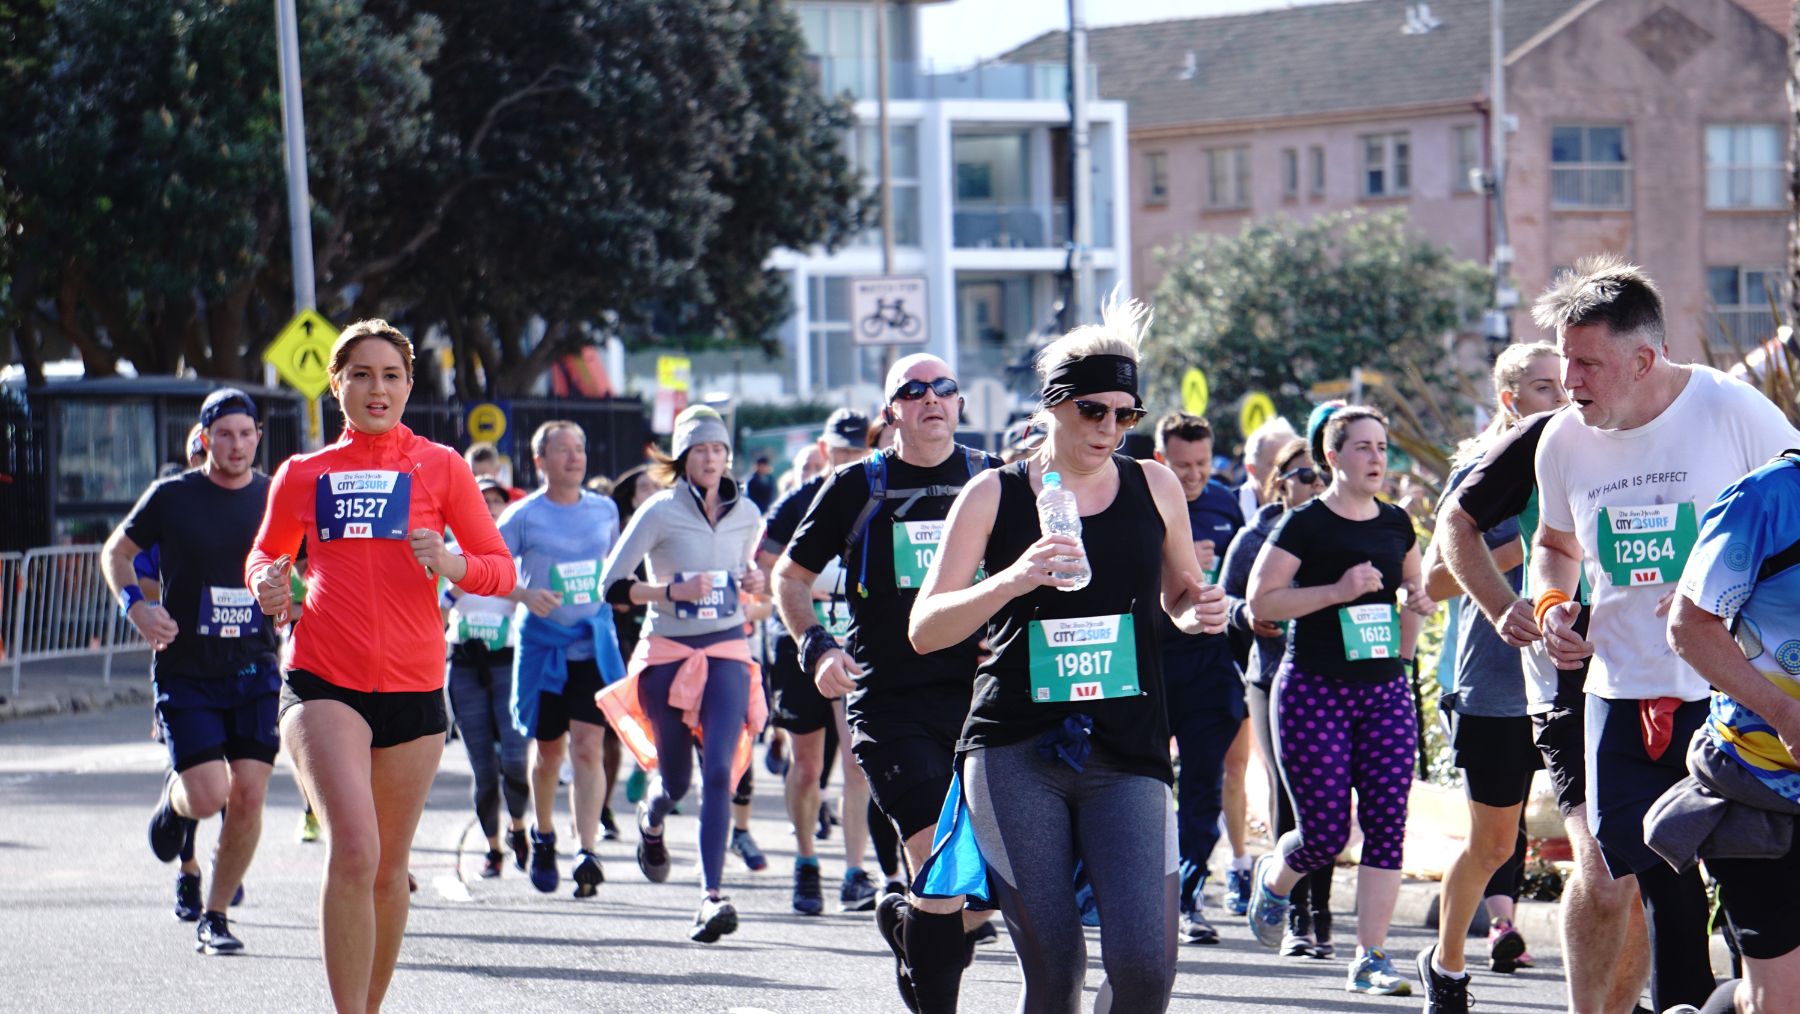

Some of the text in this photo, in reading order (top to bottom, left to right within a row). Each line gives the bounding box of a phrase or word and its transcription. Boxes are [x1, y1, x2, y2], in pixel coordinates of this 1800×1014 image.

[1588, 472, 1688, 500] MY HAIR IS PERFECT
[334, 498, 388, 519] 31527
[1614, 538, 1675, 564] 12964
[212, 607, 252, 624] 30260
[1360, 626, 1392, 643] 16123
[1055, 650, 1112, 677] 19817
